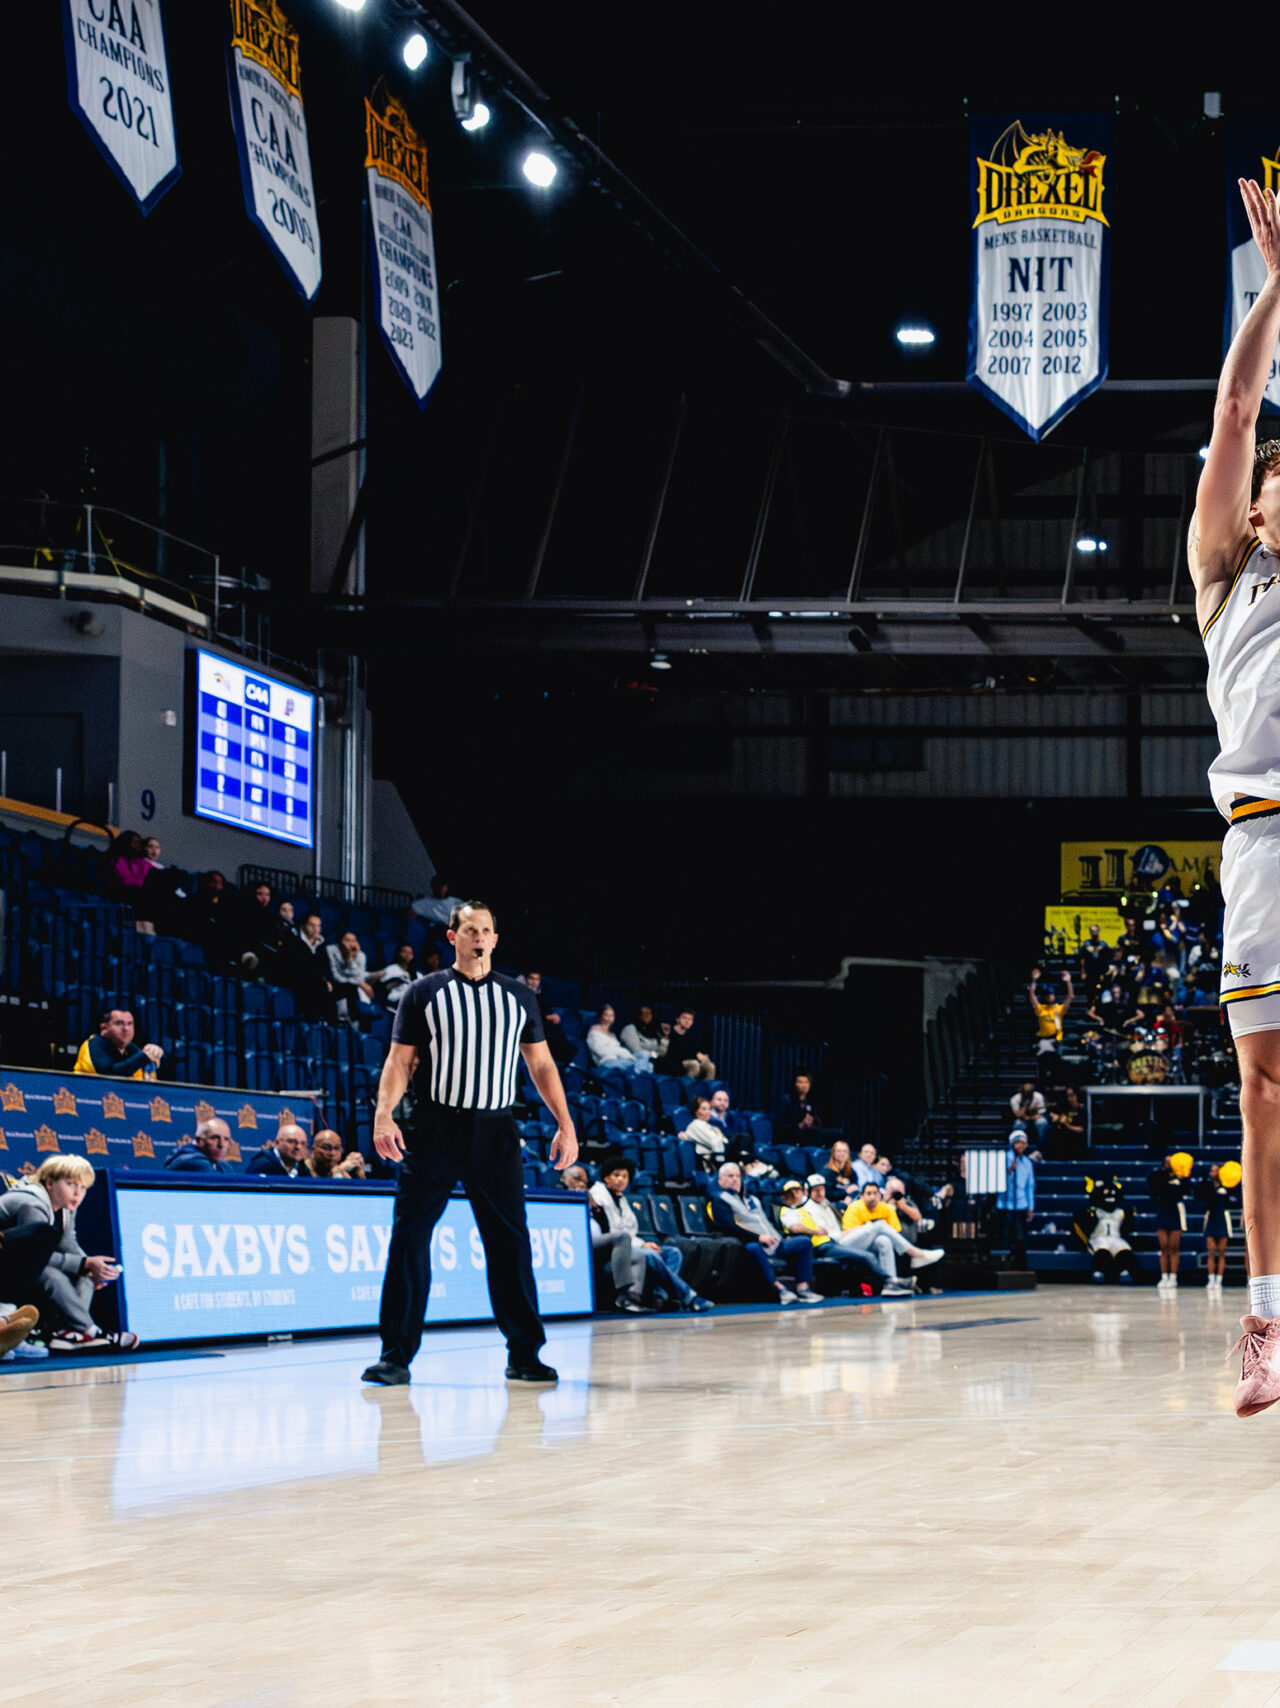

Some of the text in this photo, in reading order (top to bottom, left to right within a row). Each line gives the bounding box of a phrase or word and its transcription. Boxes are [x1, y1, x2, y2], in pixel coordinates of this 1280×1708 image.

[77, 16, 165, 94] CHAMPIONS
[99, 76, 160, 148] 2021
[250, 97, 298, 174] CAA
[985, 167, 1098, 214] DREXEL
[267, 188, 316, 254] 2009
[984, 227, 1097, 250] MENS BASKETBALL
[1008, 256, 1073, 293] NIT
[992, 301, 1088, 322] 1997 2003
[988, 328, 1088, 349] 2004 2005
[987, 355, 1082, 375] 2007 2012
[140, 788, 156, 821] 9
[141, 1223, 310, 1279] SAXBYS
